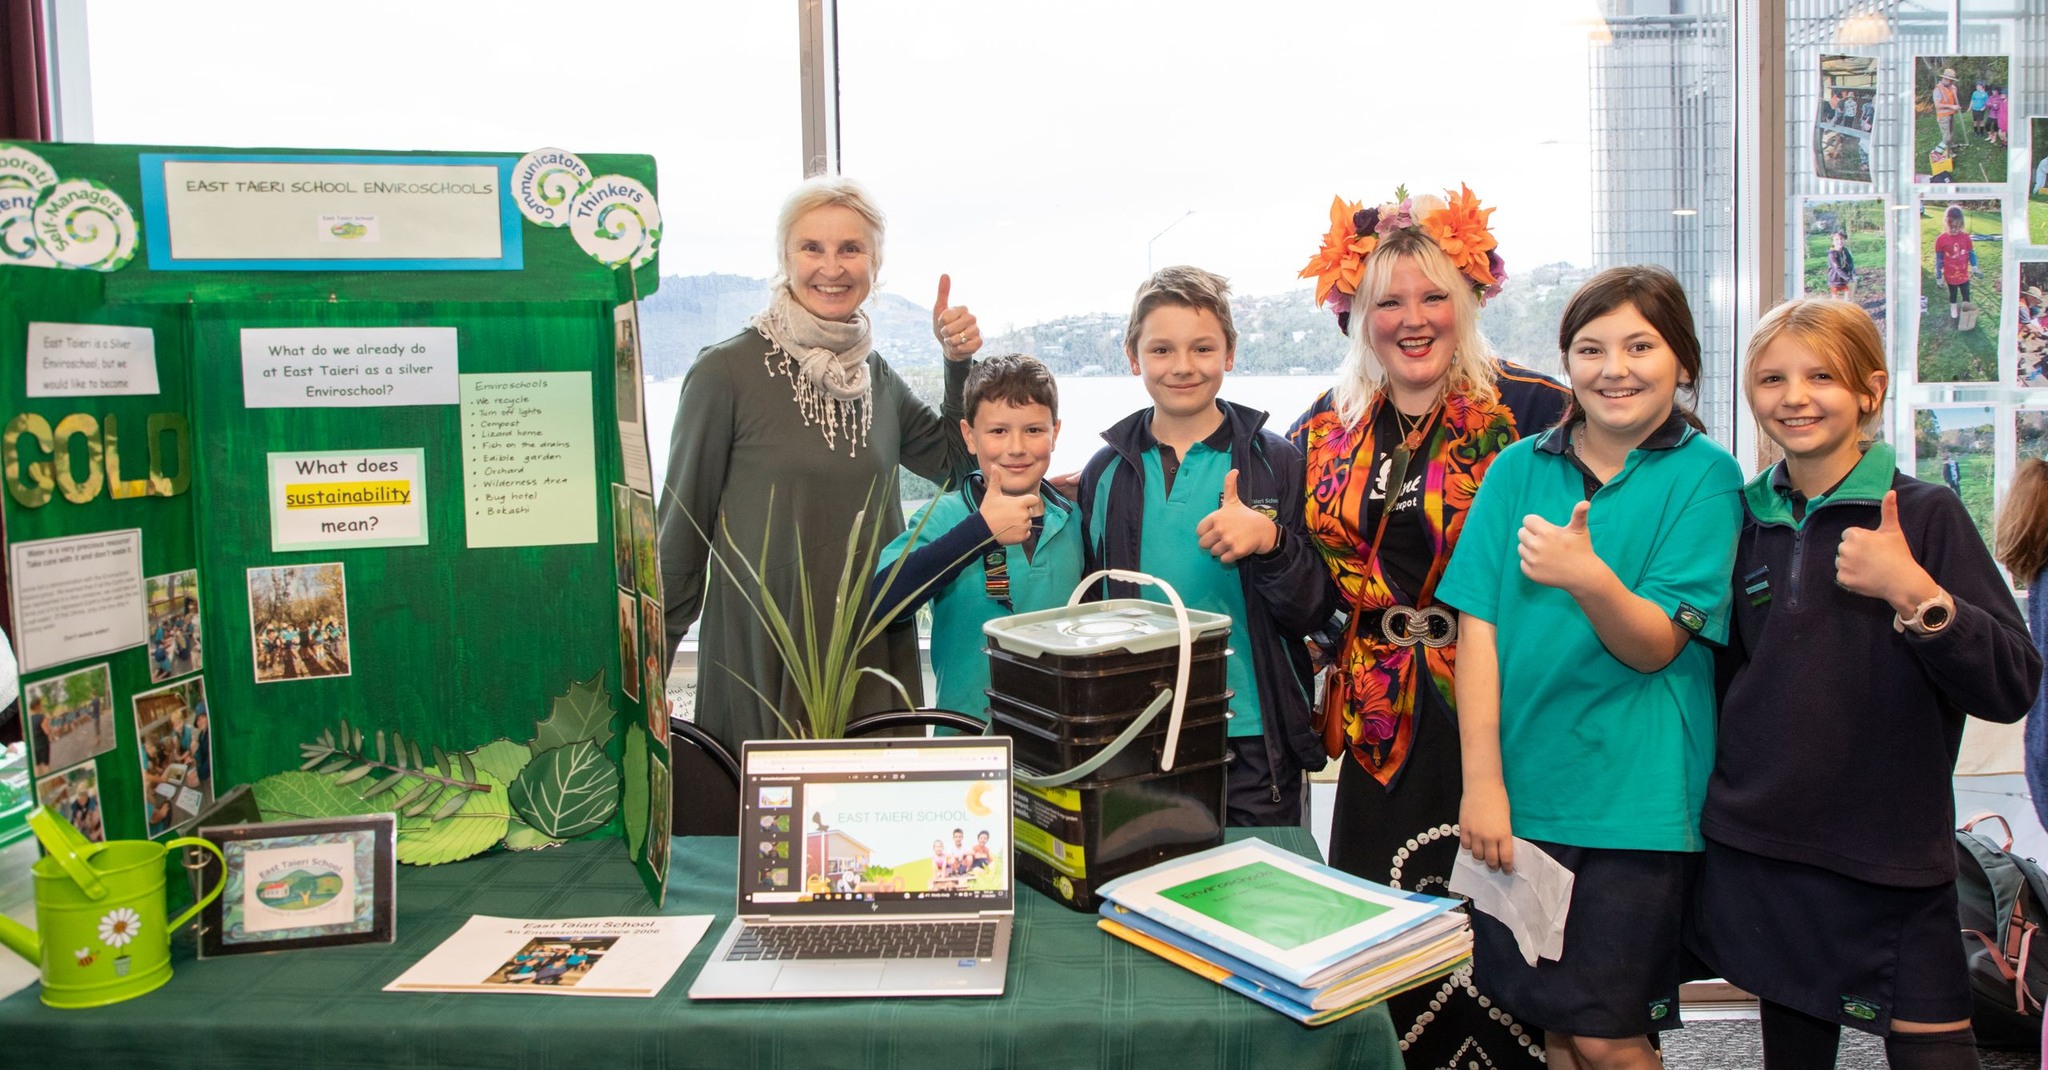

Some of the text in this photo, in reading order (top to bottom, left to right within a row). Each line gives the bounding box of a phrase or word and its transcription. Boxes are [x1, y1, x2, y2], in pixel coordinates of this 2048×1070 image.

[186, 180, 493, 195] EAST TAIERI SCHOOL ENVIROSCHOOLS
[521, 153, 586, 220] Communicators
[577, 183, 644, 219] Thinkers
[41, 189, 124, 252] Self-Managers
[43, 336, 62, 349] East
[66, 337, 92, 349] Taieri
[110, 338, 131, 349] Silver
[268, 342, 426, 357] What do we already do
[102, 359, 115, 369] but
[117, 361, 128, 369] we
[263, 363, 434, 378] at East Taieri as a silver
[43, 379, 129, 390] would like to become
[306, 384, 394, 398] Enviroschool?
[475, 380, 548, 391] Enviroschools
[476, 395, 530, 409] We recycle
[480, 406, 543, 418] Turn off lights
[480, 420, 520, 430] Compost
[481, 429, 544, 438] Lizard home
[482, 441, 502, 449] Fish
[540, 440, 571, 449] drains
[3, 411, 191, 509] GOLD
[483, 453, 562, 464] Edible garden
[295, 457, 399, 475] What does
[484, 466, 525, 476] Orchard
[483, 476, 568, 488] Wilderness Area
[286, 486, 411, 507] sustainability
[485, 490, 538, 504] Bug hotel
[487, 505, 530, 516] Bokashi
[321, 516, 379, 533] mean?
[838, 810, 970, 824] EAST TAIERI SCHOOL
[258, 857, 344, 879] East Taieri School
[522, 922, 556, 930] East
[603, 920, 656, 928] School
